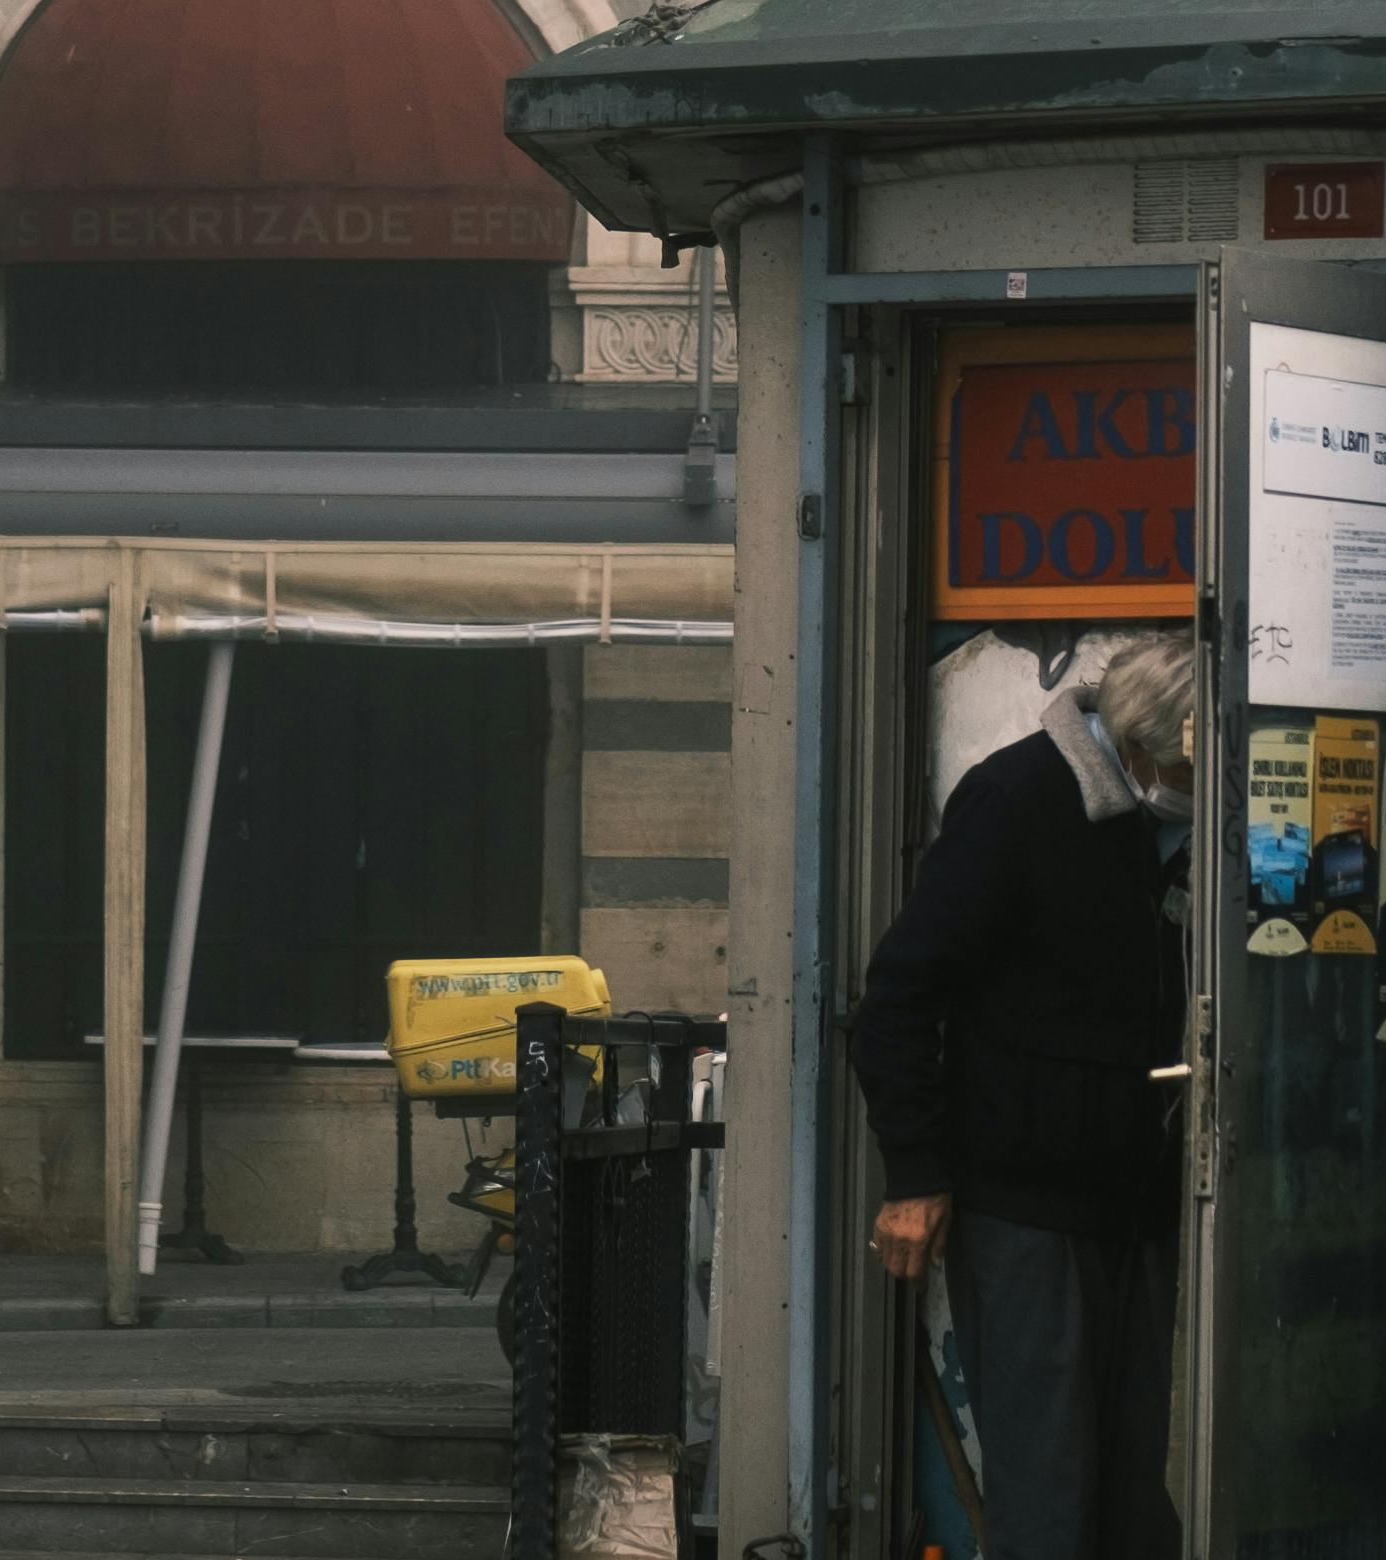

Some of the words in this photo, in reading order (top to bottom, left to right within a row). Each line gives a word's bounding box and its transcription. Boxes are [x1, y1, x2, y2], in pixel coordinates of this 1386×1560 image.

[68, 192, 413, 247] BEKRİZADE
[1294, 183, 1351, 221] 101
[1007, 384, 1195, 461] AKB
